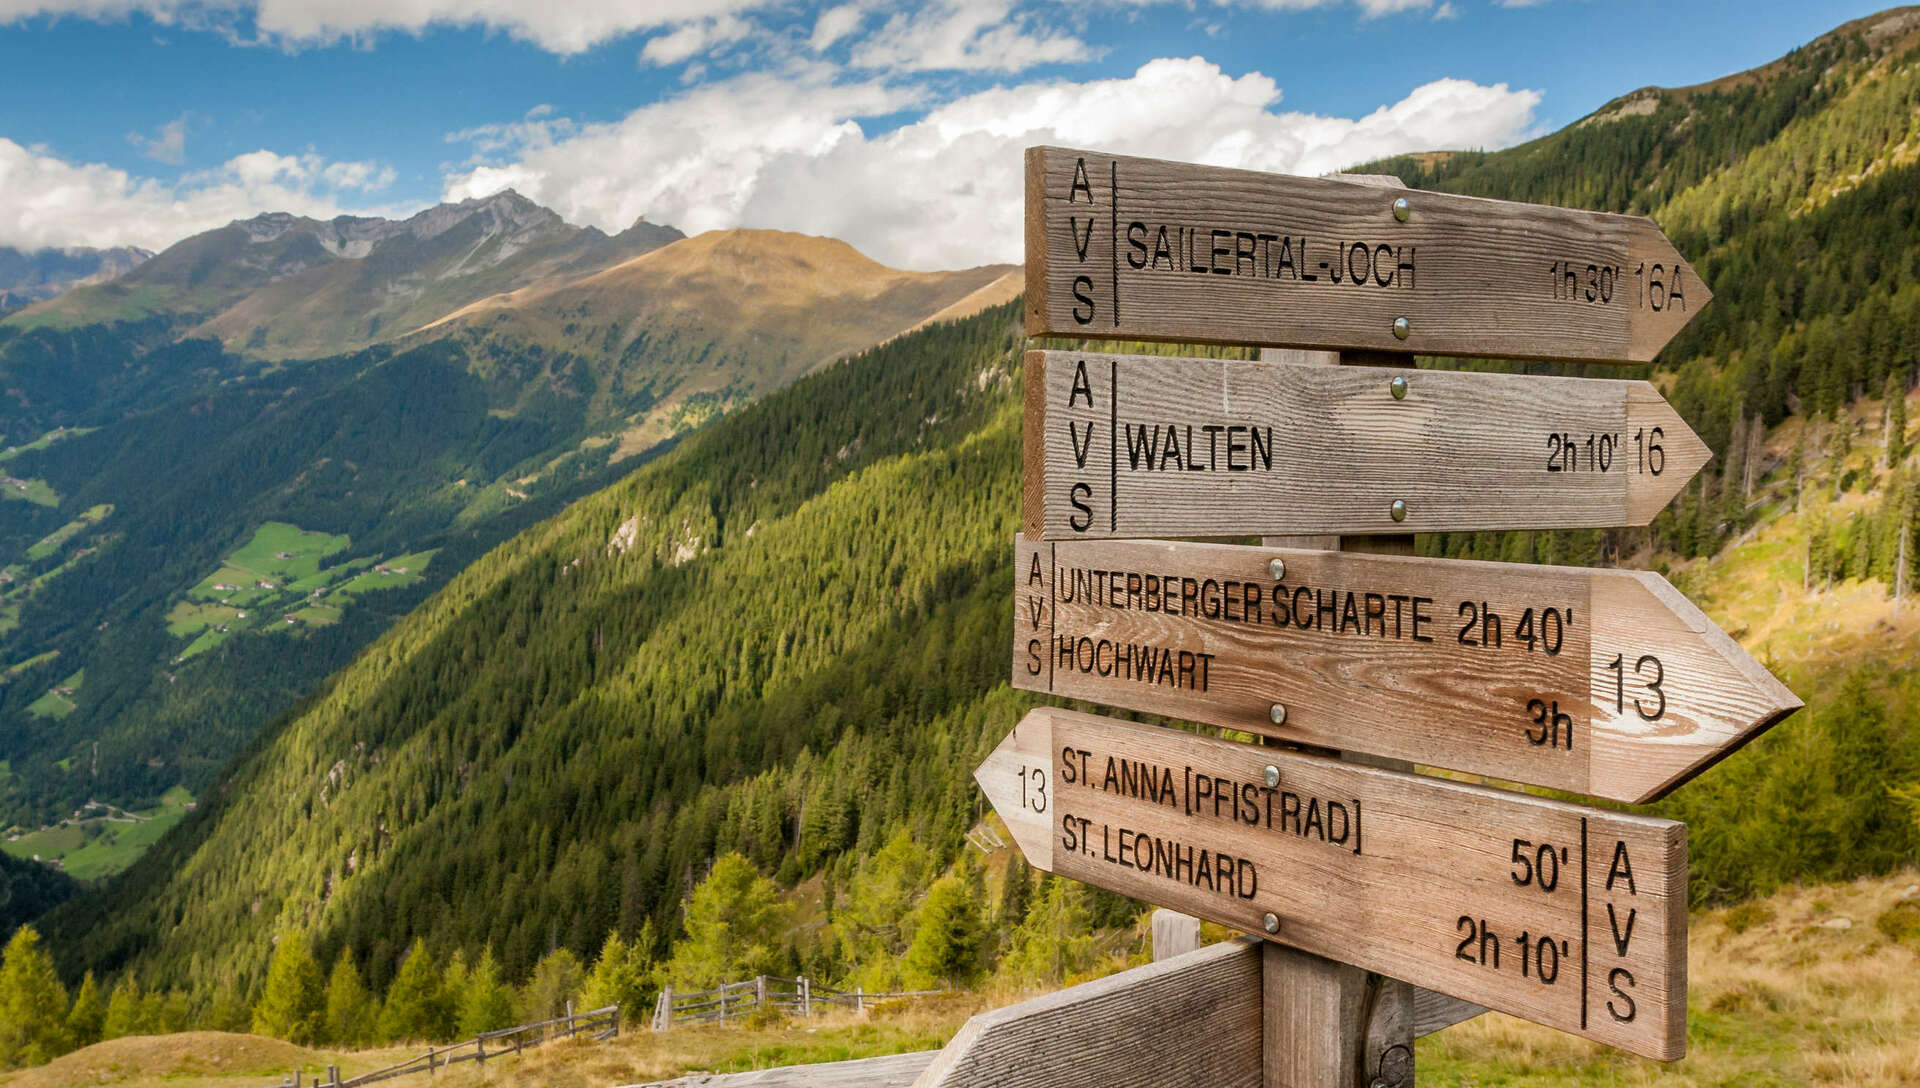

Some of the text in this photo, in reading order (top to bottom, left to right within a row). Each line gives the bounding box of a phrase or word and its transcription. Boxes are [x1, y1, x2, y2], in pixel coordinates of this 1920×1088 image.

[1126, 220, 1619, 304] SAILERTAL-JOCH 1h 30'
[1634, 262, 1687, 312] 16A
[1125, 422, 1618, 473] WALTEN 2h 10'
[1634, 426, 1665, 476] 16
[1060, 567, 1573, 656] UNTERBERGER SCHARTE 2h 40'
[1058, 634, 1572, 750] HOCHWART 3h
[1608, 652, 1666, 722] 13
[1017, 765, 1047, 813] 13
[1061, 747, 1568, 893] ST. ANNA [PFISTRAD] 50'
[1062, 814, 1568, 985] ST. LEONHARD 2h 10'
